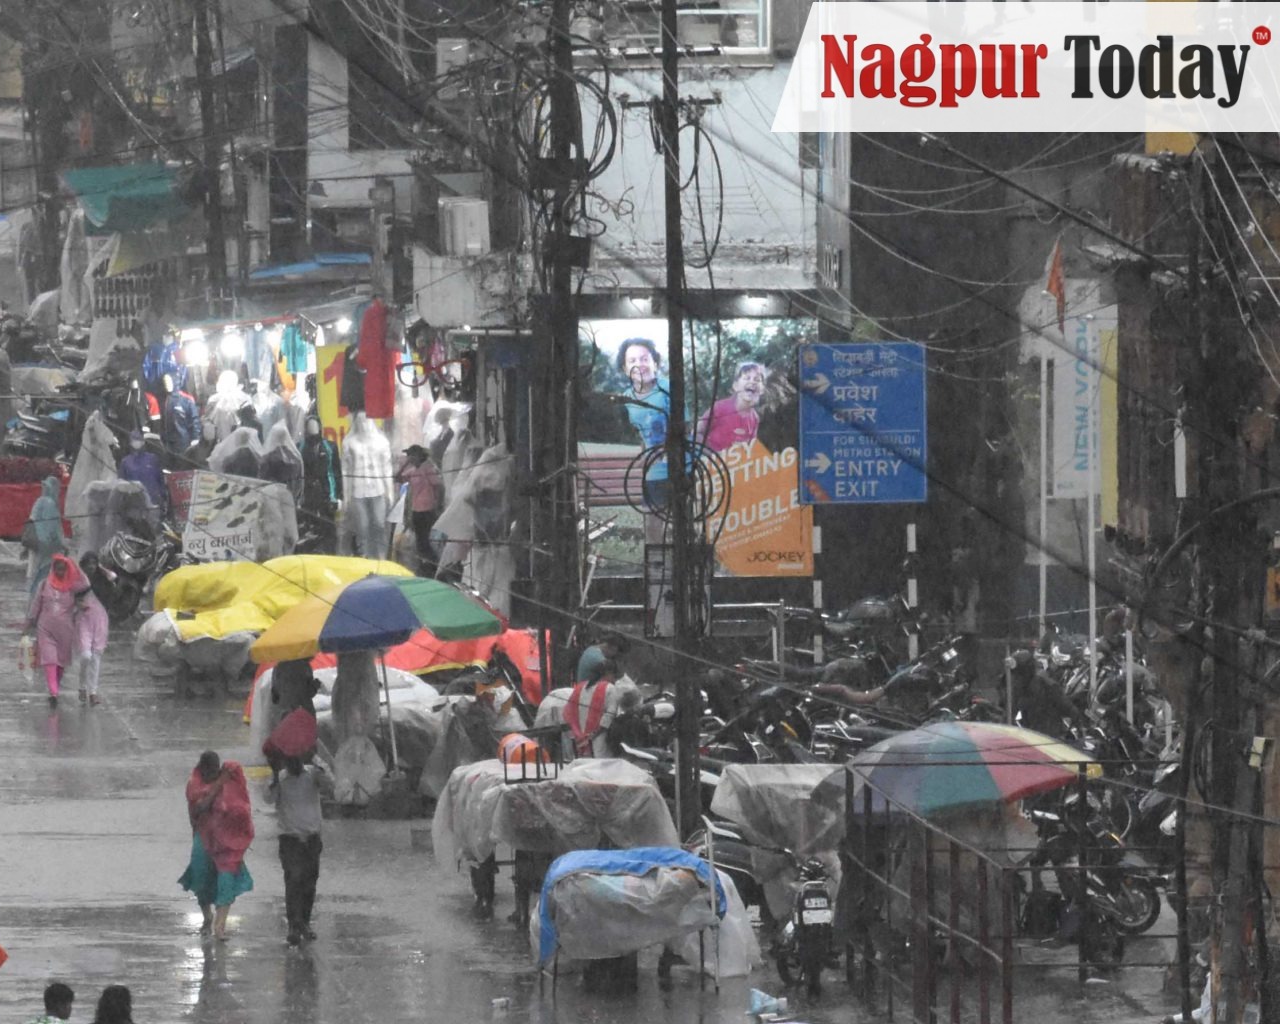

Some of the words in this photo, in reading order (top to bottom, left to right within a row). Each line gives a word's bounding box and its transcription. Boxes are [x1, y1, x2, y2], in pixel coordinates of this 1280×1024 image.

[833, 380, 878, 402] प्रवेश
[833, 435, 855, 446] FOR
[1073, 406, 1089, 471] NEW
[833, 447, 872, 458] METRO
[875, 447, 921, 457] STAON
[835, 460, 902, 477] ENTRY
[835, 480, 879, 497] EXIT
[747, 551, 806, 563] JOCKEY
